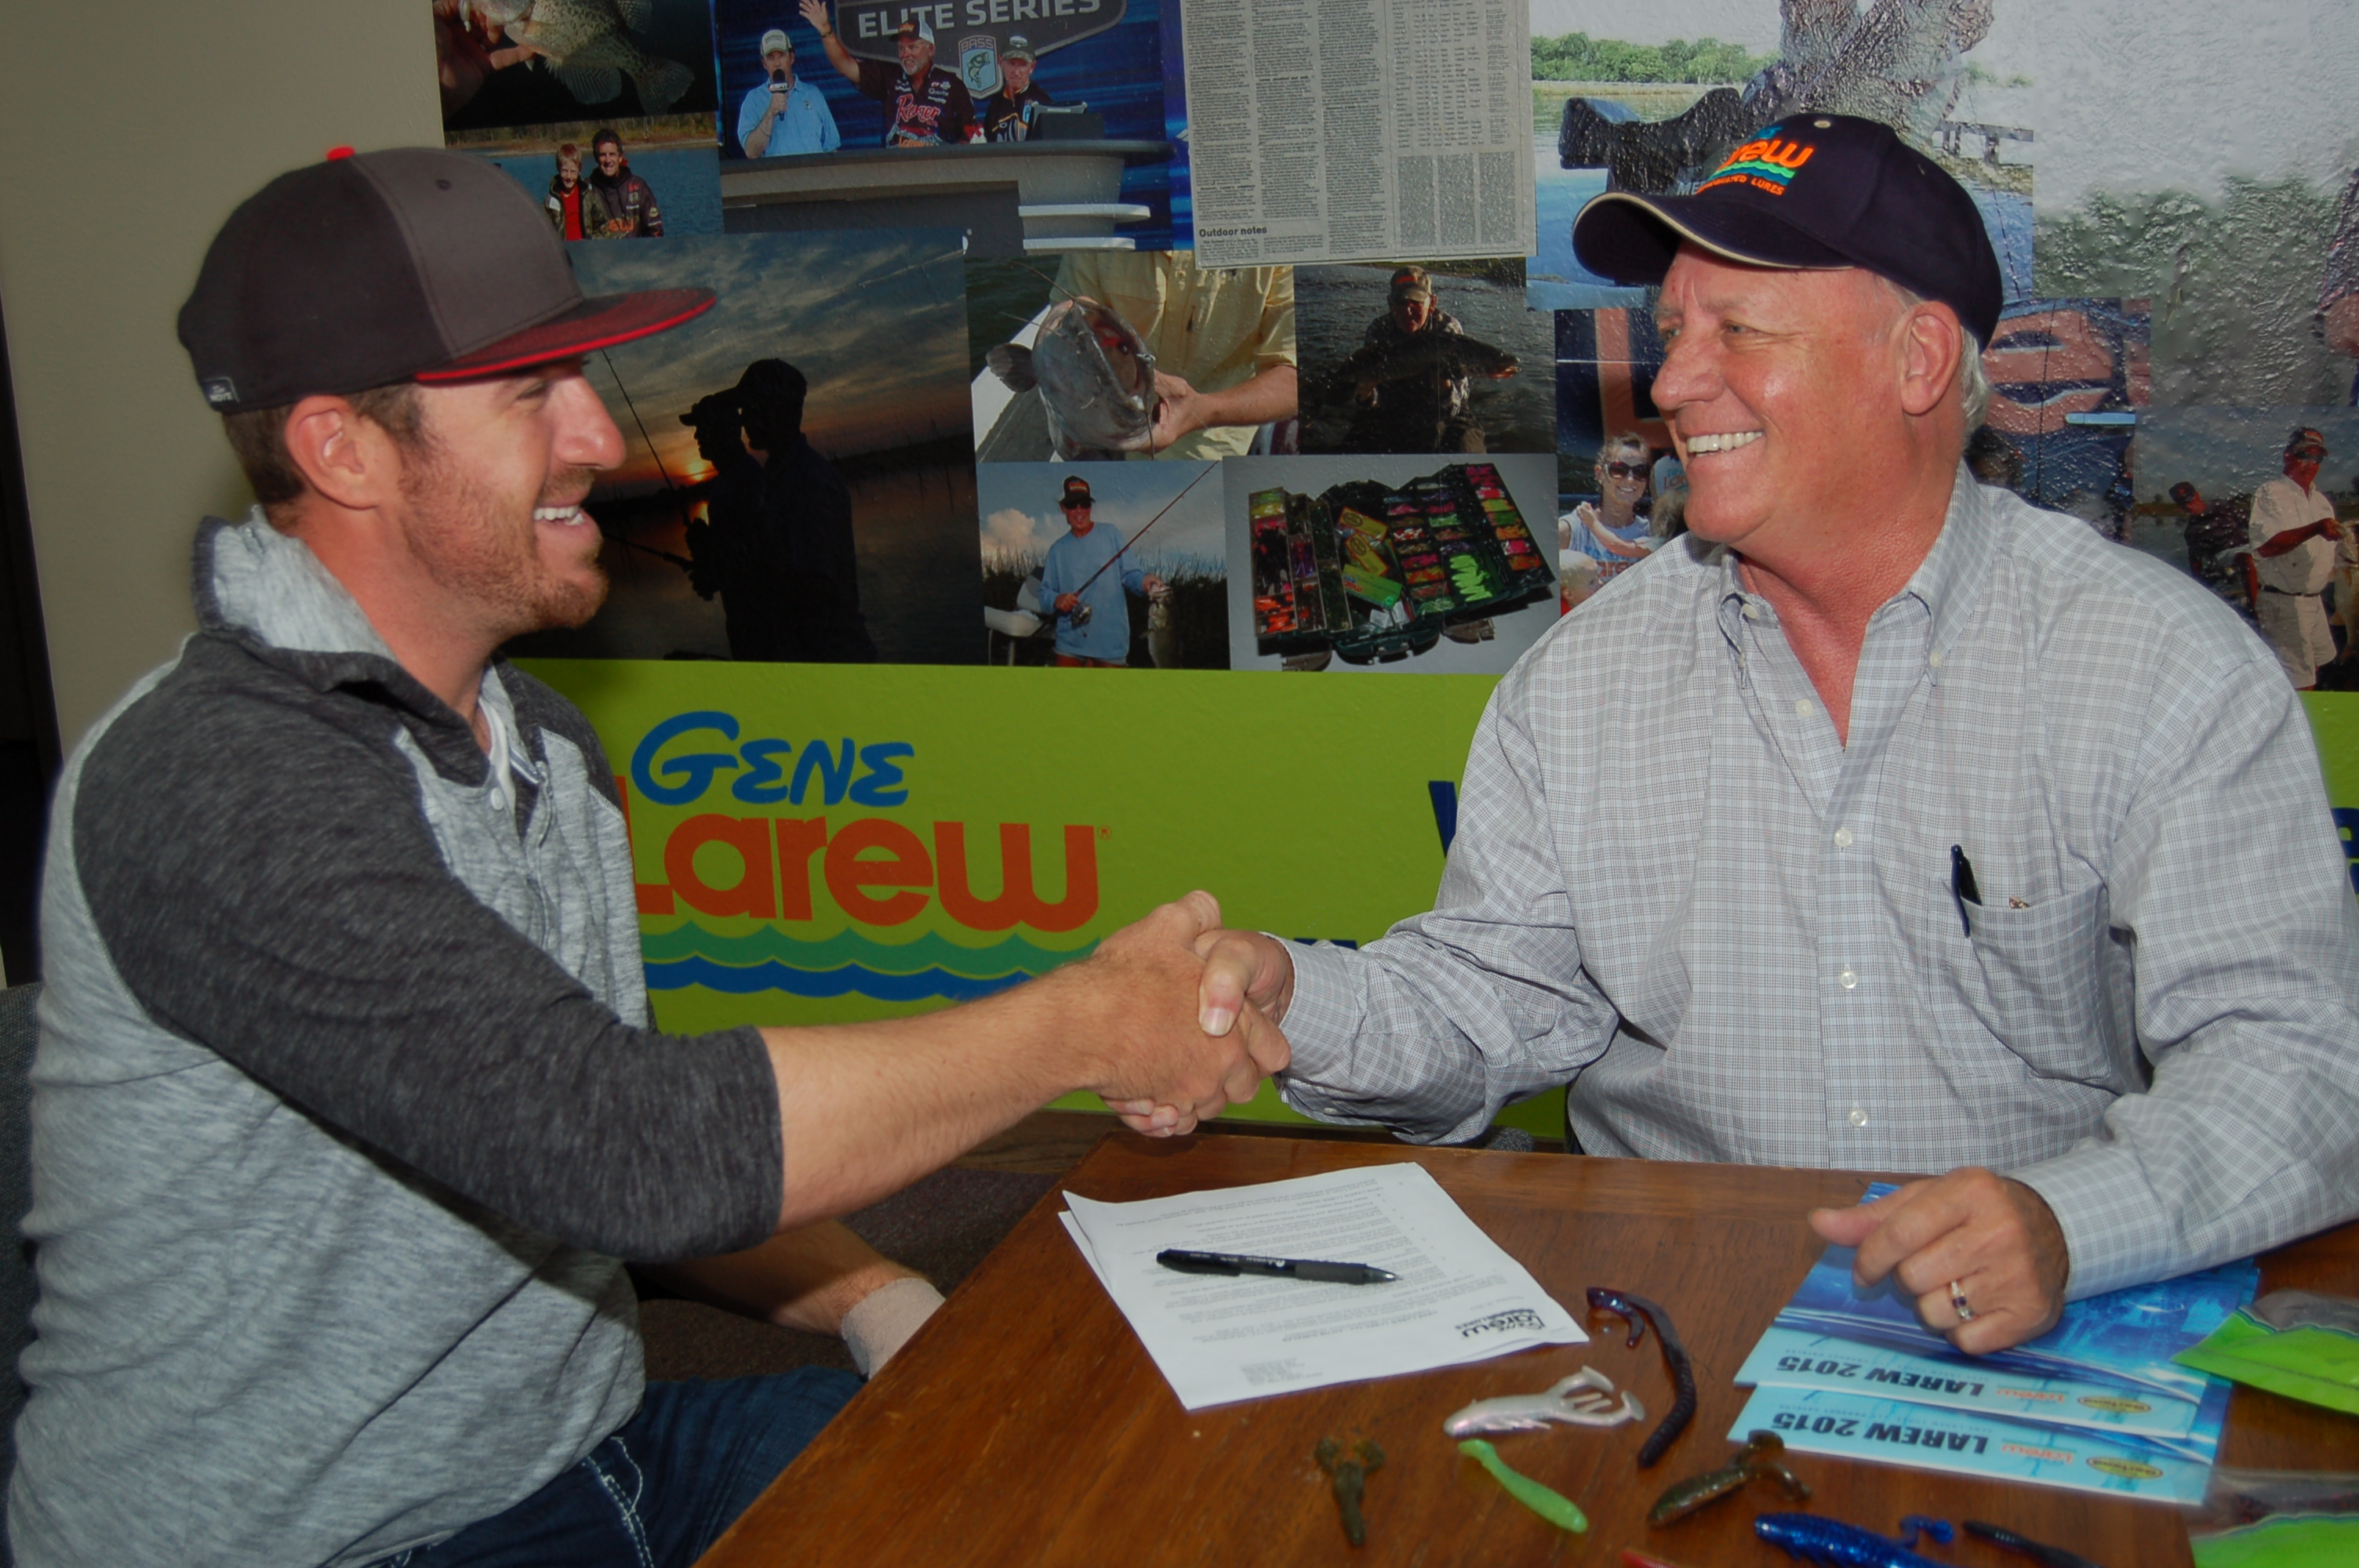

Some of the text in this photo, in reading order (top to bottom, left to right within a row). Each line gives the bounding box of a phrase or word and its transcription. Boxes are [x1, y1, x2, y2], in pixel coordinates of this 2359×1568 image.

[858, 0, 1100, 38] ELITE SERIES
[961, 36, 996, 52] BASS
[1750, 177, 1786, 195] LURES
[1198, 225, 1267, 238] Outdoor notes
[1776, 1356, 1985, 1396] LAREW 2015
[1771, 1412, 1989, 1454] LAREW 2015
